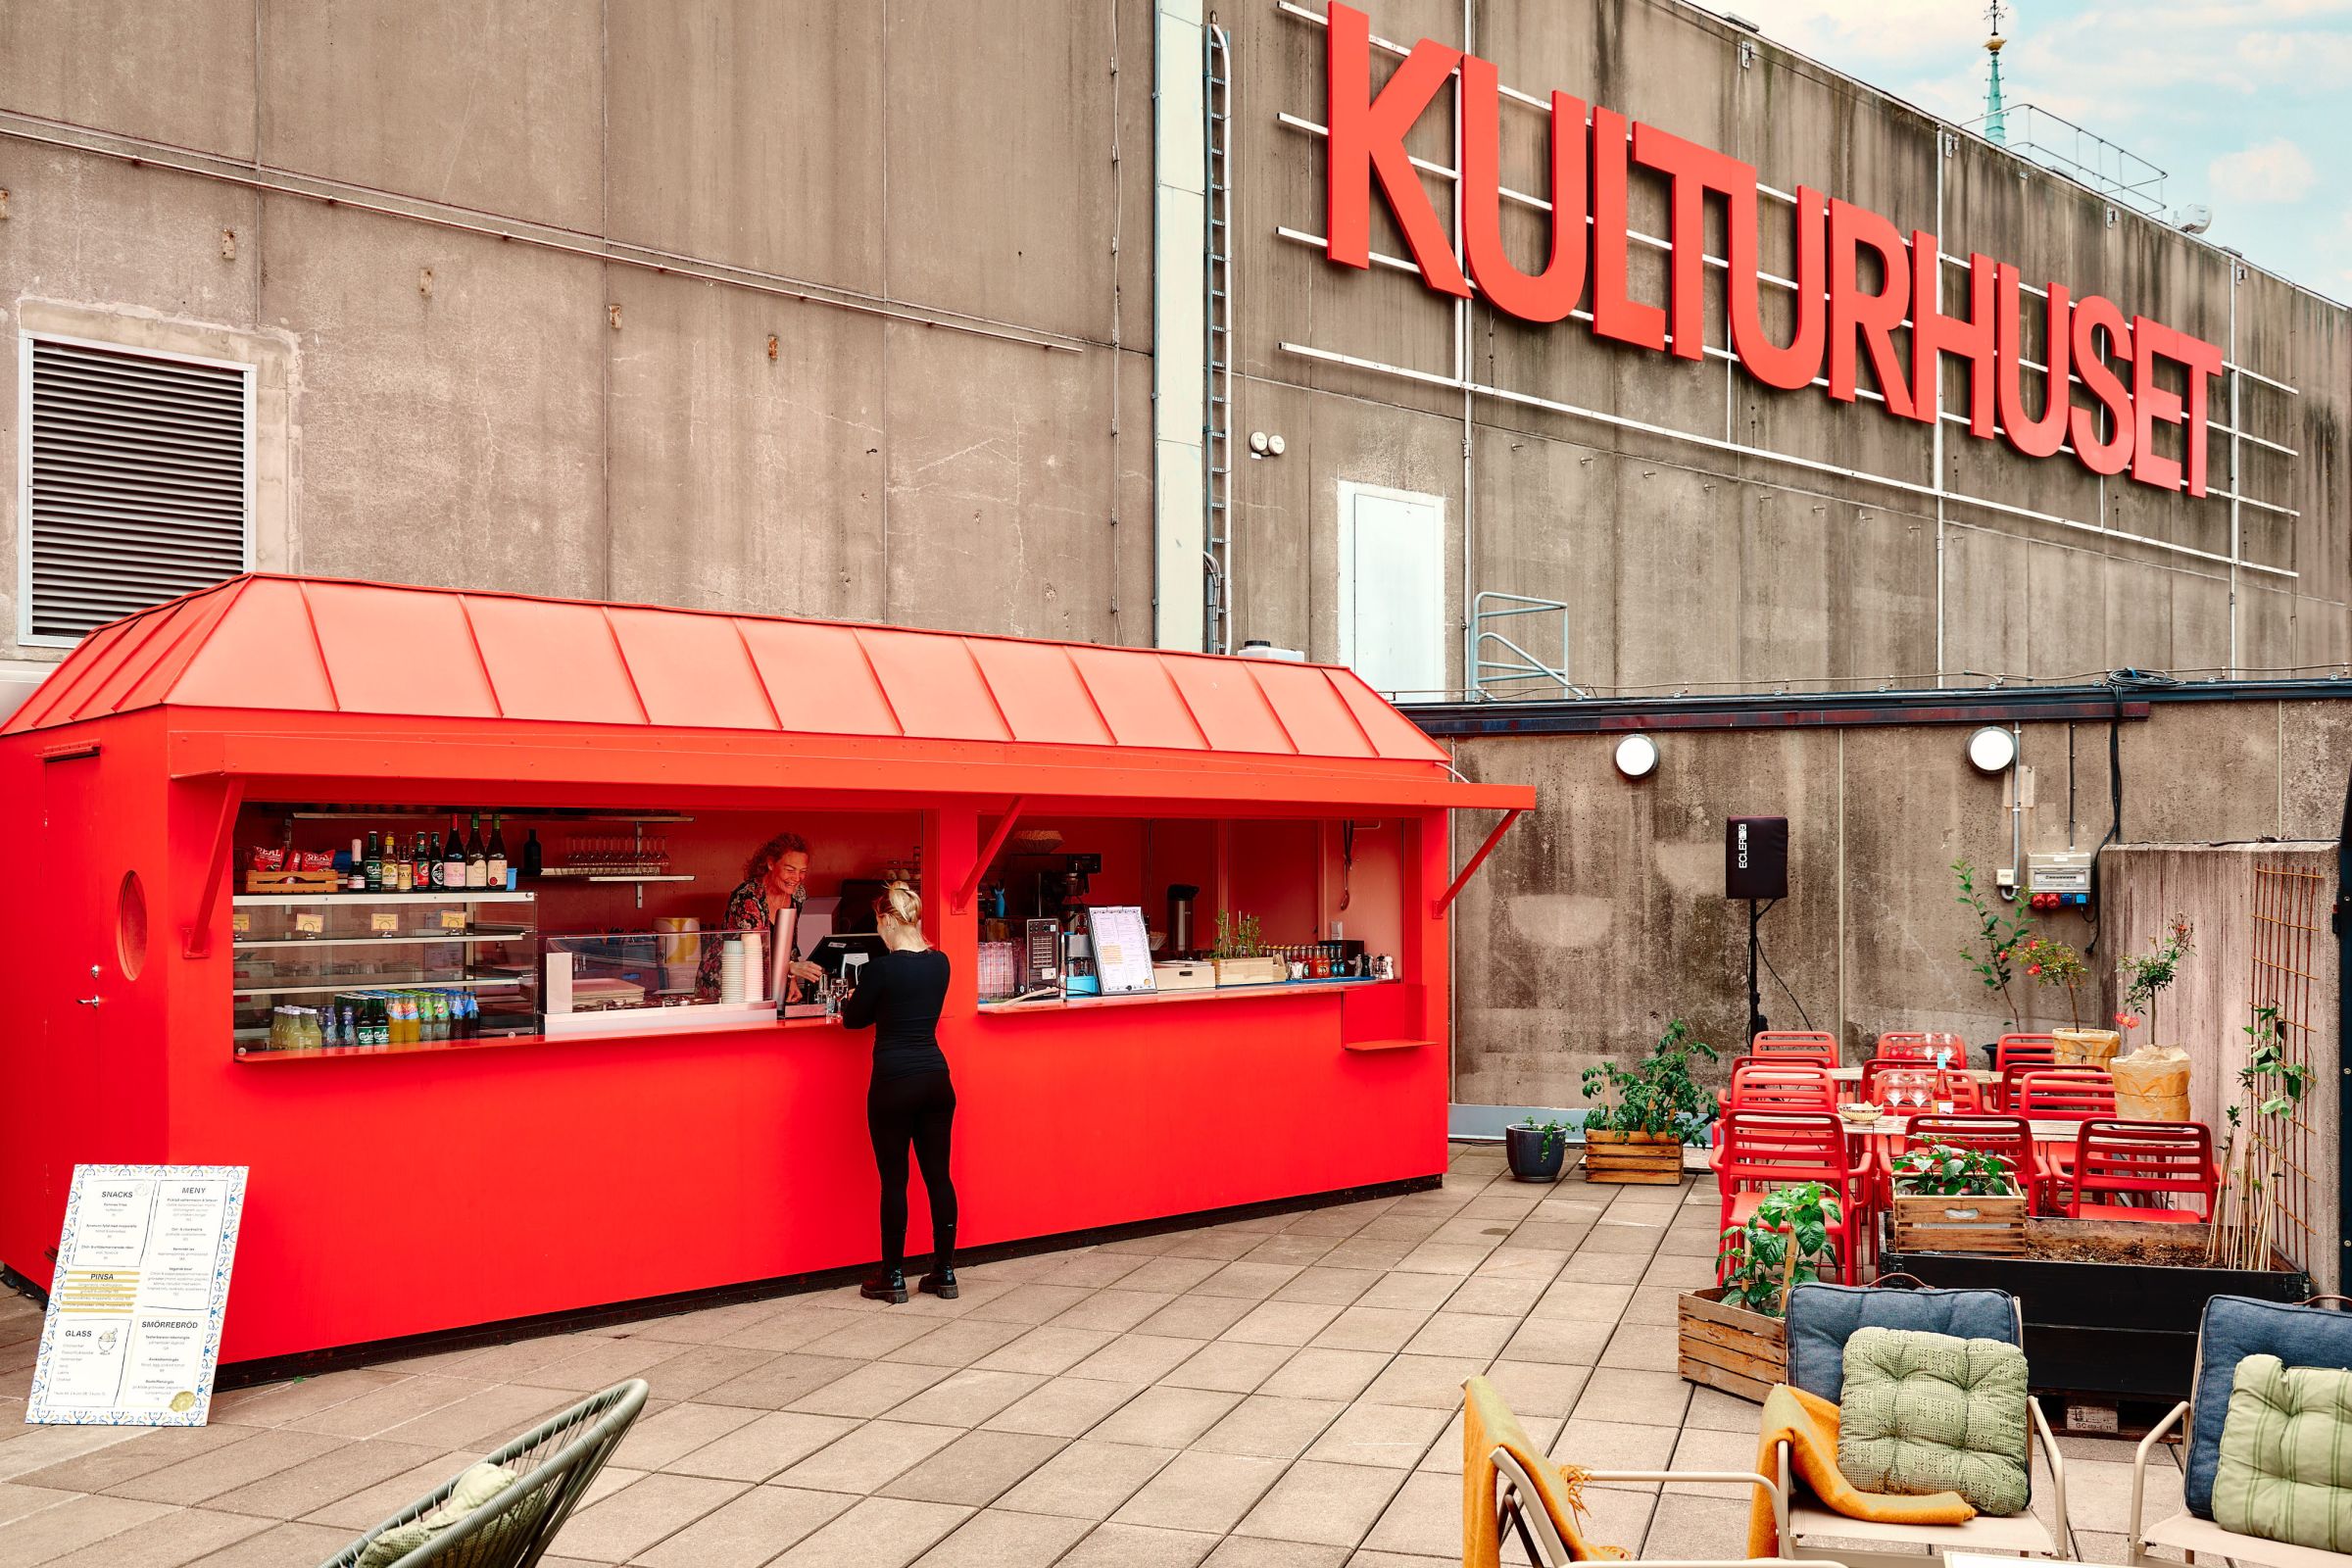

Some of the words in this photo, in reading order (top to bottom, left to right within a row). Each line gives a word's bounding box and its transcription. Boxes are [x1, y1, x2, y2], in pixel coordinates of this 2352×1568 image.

[1328, 1, 2223, 498] KULTURHUSET
[1739, 838, 1748, 869] ECLER
[141, 1320, 199, 1329] SMÖRREBRÖD
